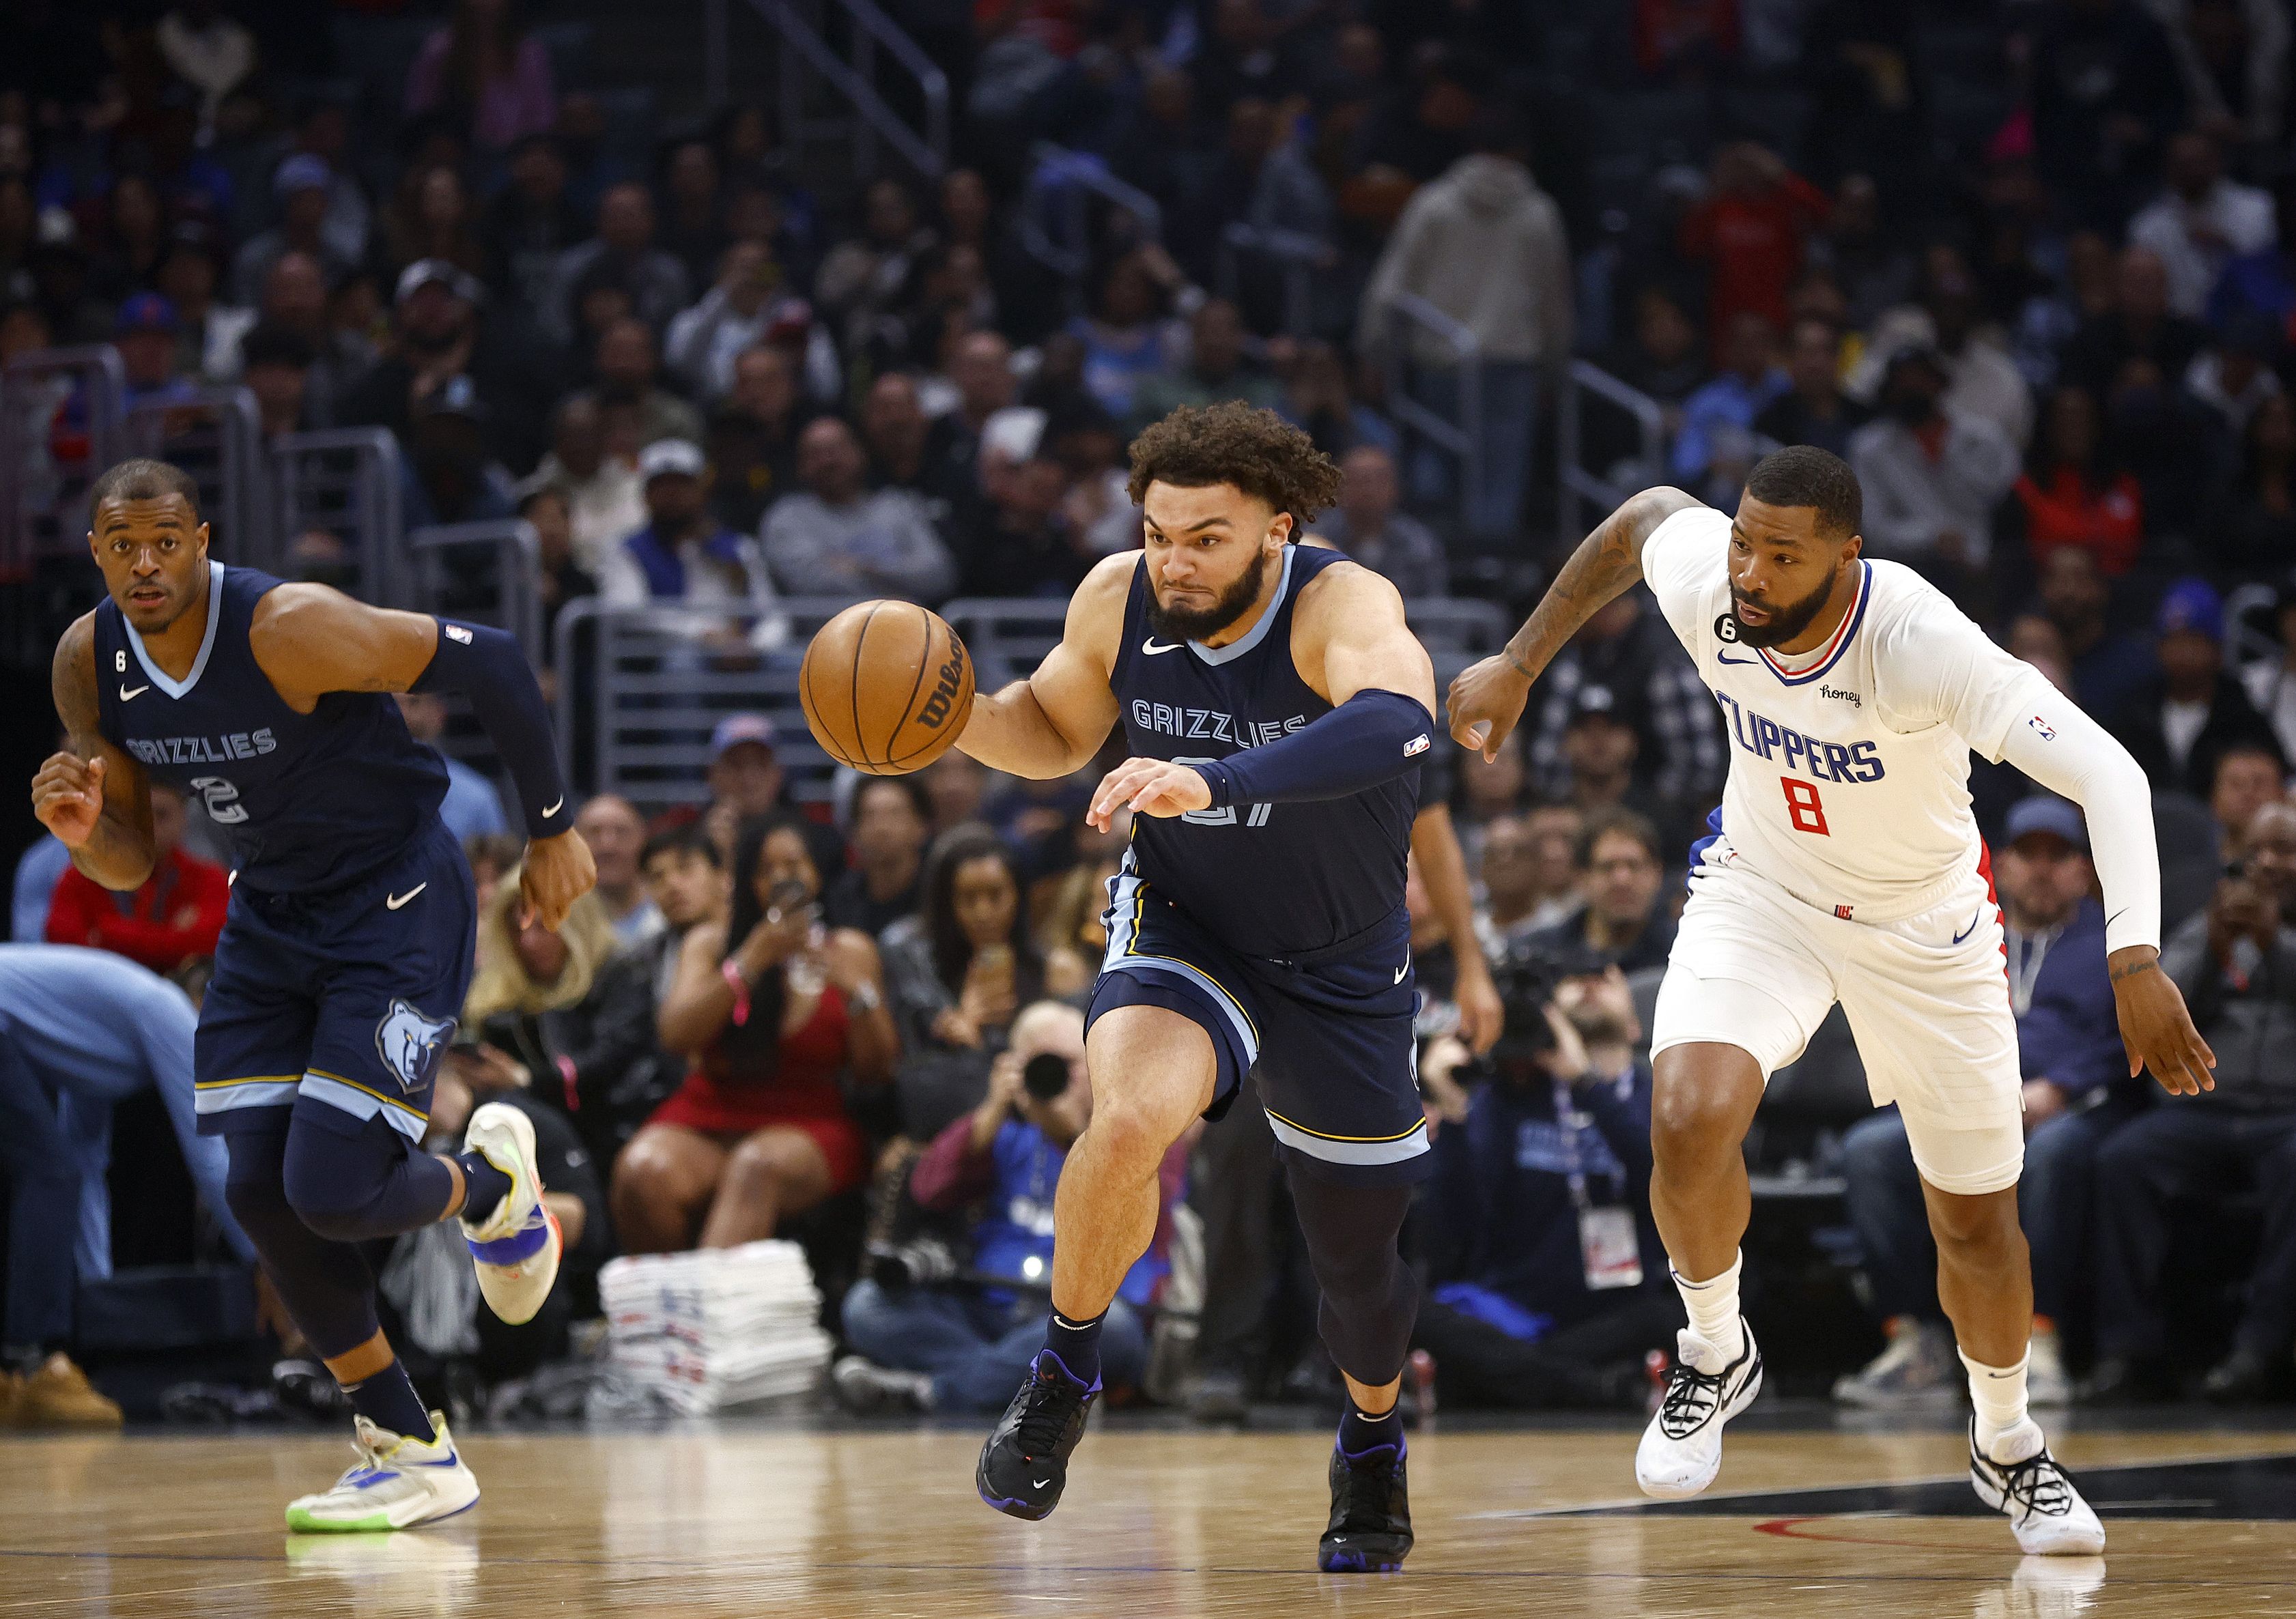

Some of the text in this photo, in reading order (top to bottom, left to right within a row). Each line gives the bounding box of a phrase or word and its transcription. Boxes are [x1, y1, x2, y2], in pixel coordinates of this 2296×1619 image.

[1720, 617, 1736, 640] 6
[115, 649, 127, 672] 6
[916, 625, 963, 728] Wilson
[1819, 684, 1861, 708] honey
[190, 776, 249, 824] 2
[1780, 776, 1830, 837] 8
